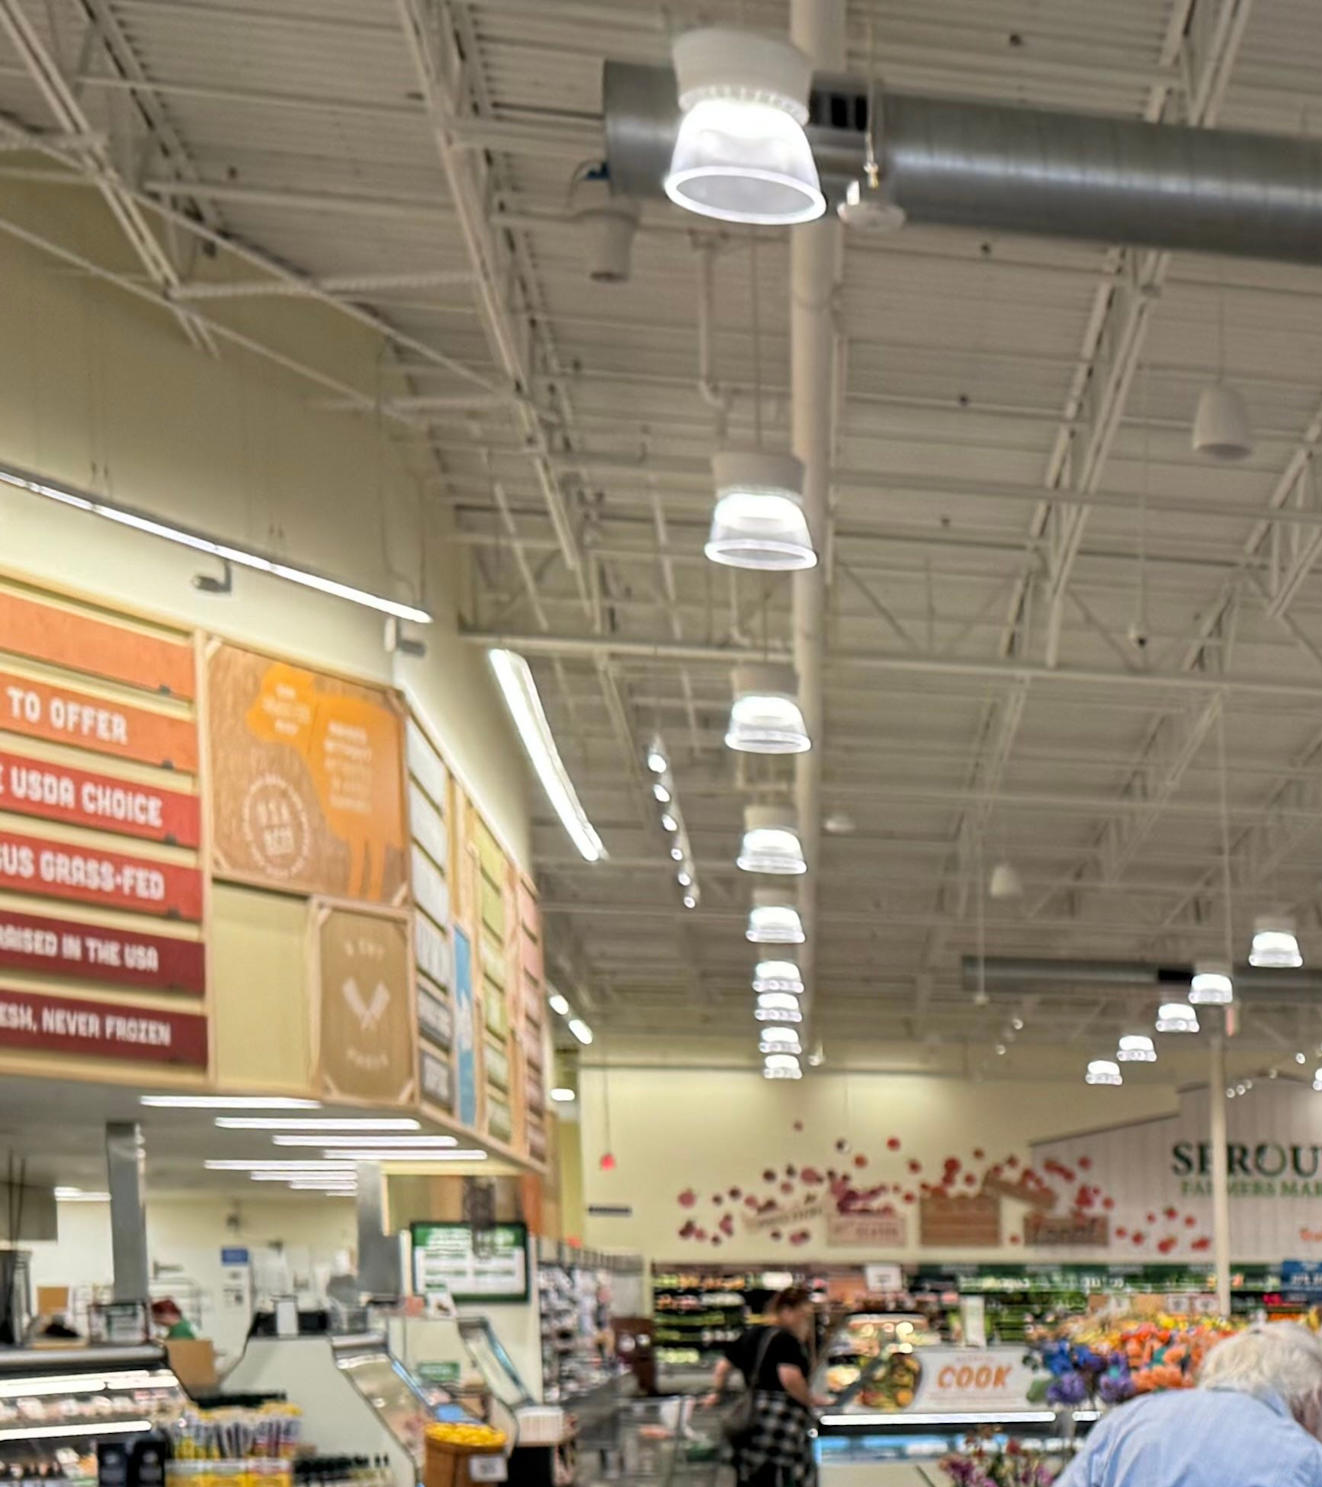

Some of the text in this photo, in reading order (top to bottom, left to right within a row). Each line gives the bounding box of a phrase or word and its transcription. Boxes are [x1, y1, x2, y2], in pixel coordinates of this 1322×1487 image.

[7, 686, 128, 745] TO OFFER
[10, 765, 75, 809] USDA
[81, 781, 163, 829] CHOICE
[0, 842, 34, 878] US
[62, 932, 82, 961] IN
[85, 937, 121, 968] THE
[124, 942, 159, 973] USA
[42, 1006, 100, 1039] NEVER
[105, 1013, 171, 1047] FROZEN
[937, 1364, 1013, 1390] COOK
